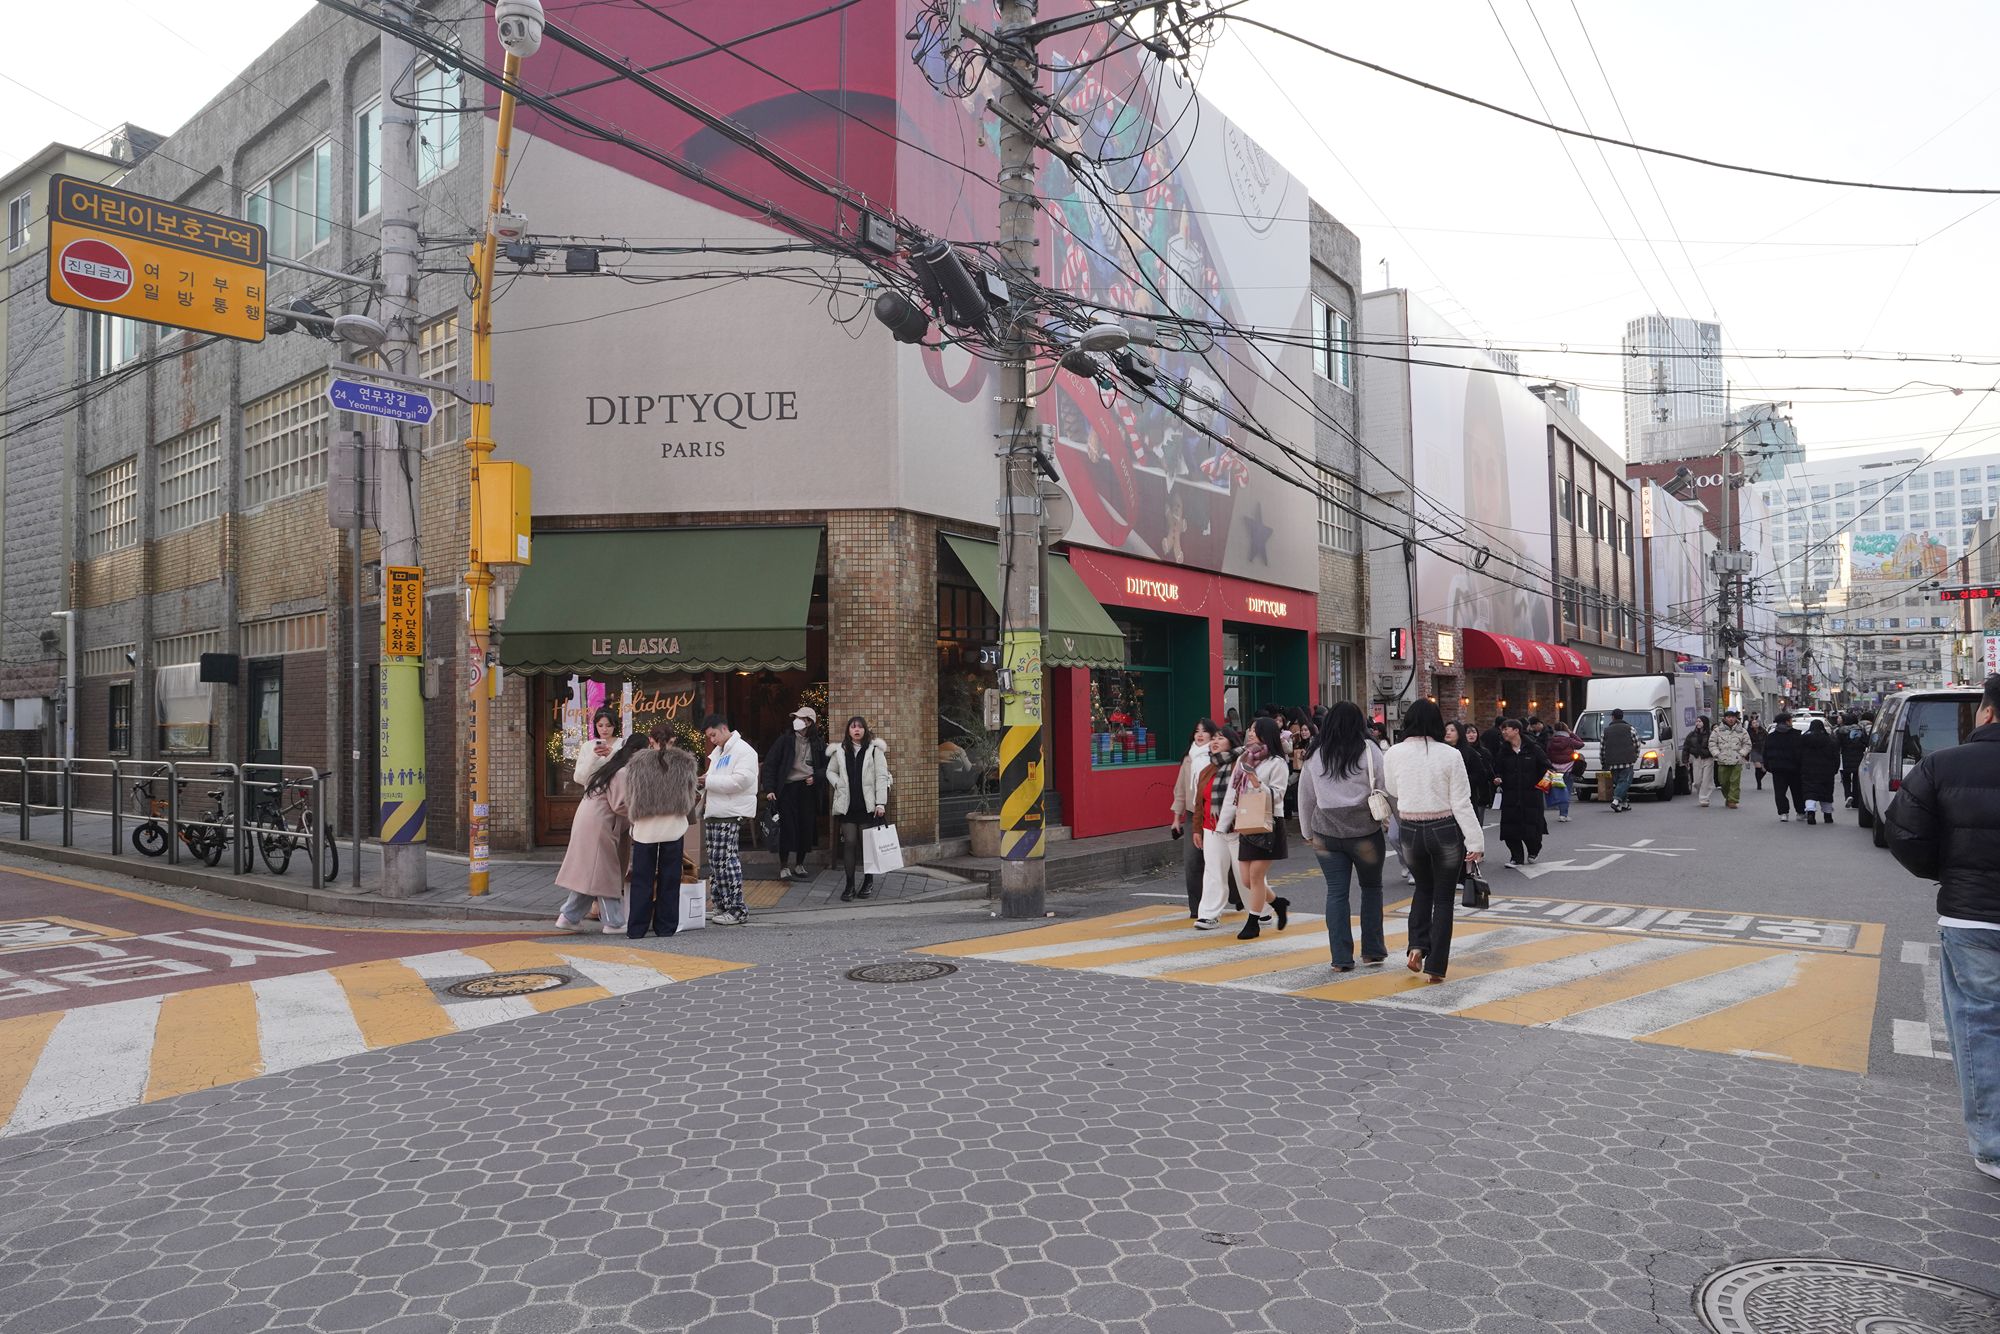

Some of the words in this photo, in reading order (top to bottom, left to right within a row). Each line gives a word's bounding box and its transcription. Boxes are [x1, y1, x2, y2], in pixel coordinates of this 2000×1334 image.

[71, 192, 251, 256] 어린이보호구역
[67, 259, 127, 284] 진입금지
[335, 389, 347, 400] 24
[359, 387, 407, 408] 연무장길
[417, 405, 429, 415] 20
[348, 399, 417, 419] Yeonmujang-gil
[586, 391, 798, 430] DIPTYQUE
[661, 441, 726, 459] PARIS
[391, 584, 403, 607] 불법
[406, 583, 417, 617] CCTV
[1126, 576, 1179, 602] DIPTYQUE
[1248, 597, 1287, 618] DIPTYQUE
[405, 619, 417, 652] 단속중
[592, 638, 612, 655] LE
[617, 637, 680, 655] ALASKA
